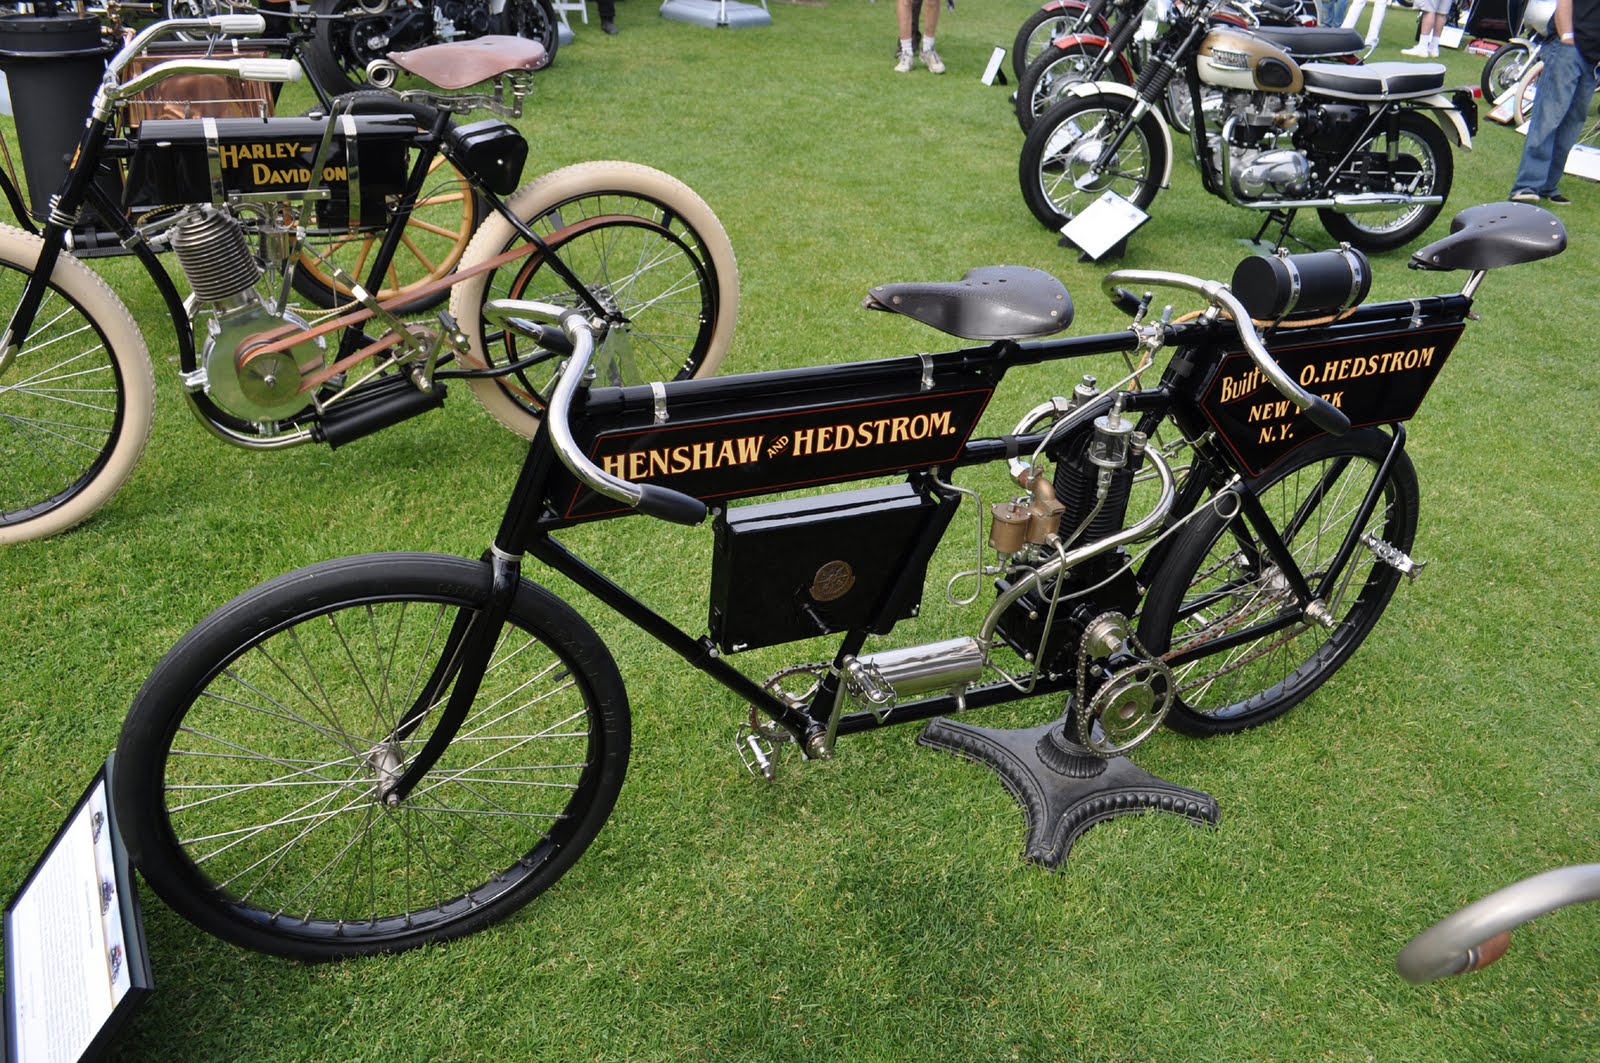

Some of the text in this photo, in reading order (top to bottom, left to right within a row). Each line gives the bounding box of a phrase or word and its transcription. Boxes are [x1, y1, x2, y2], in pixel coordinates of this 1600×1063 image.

[252, 163, 347, 184] DAVIDON
[1220, 366, 1260, 403] Built
[1248, 400, 1290, 422] NEW
[1258, 423, 1294, 444] N.Y.
[602, 410, 957, 481] HENSHAW AND HEDSTROM.
